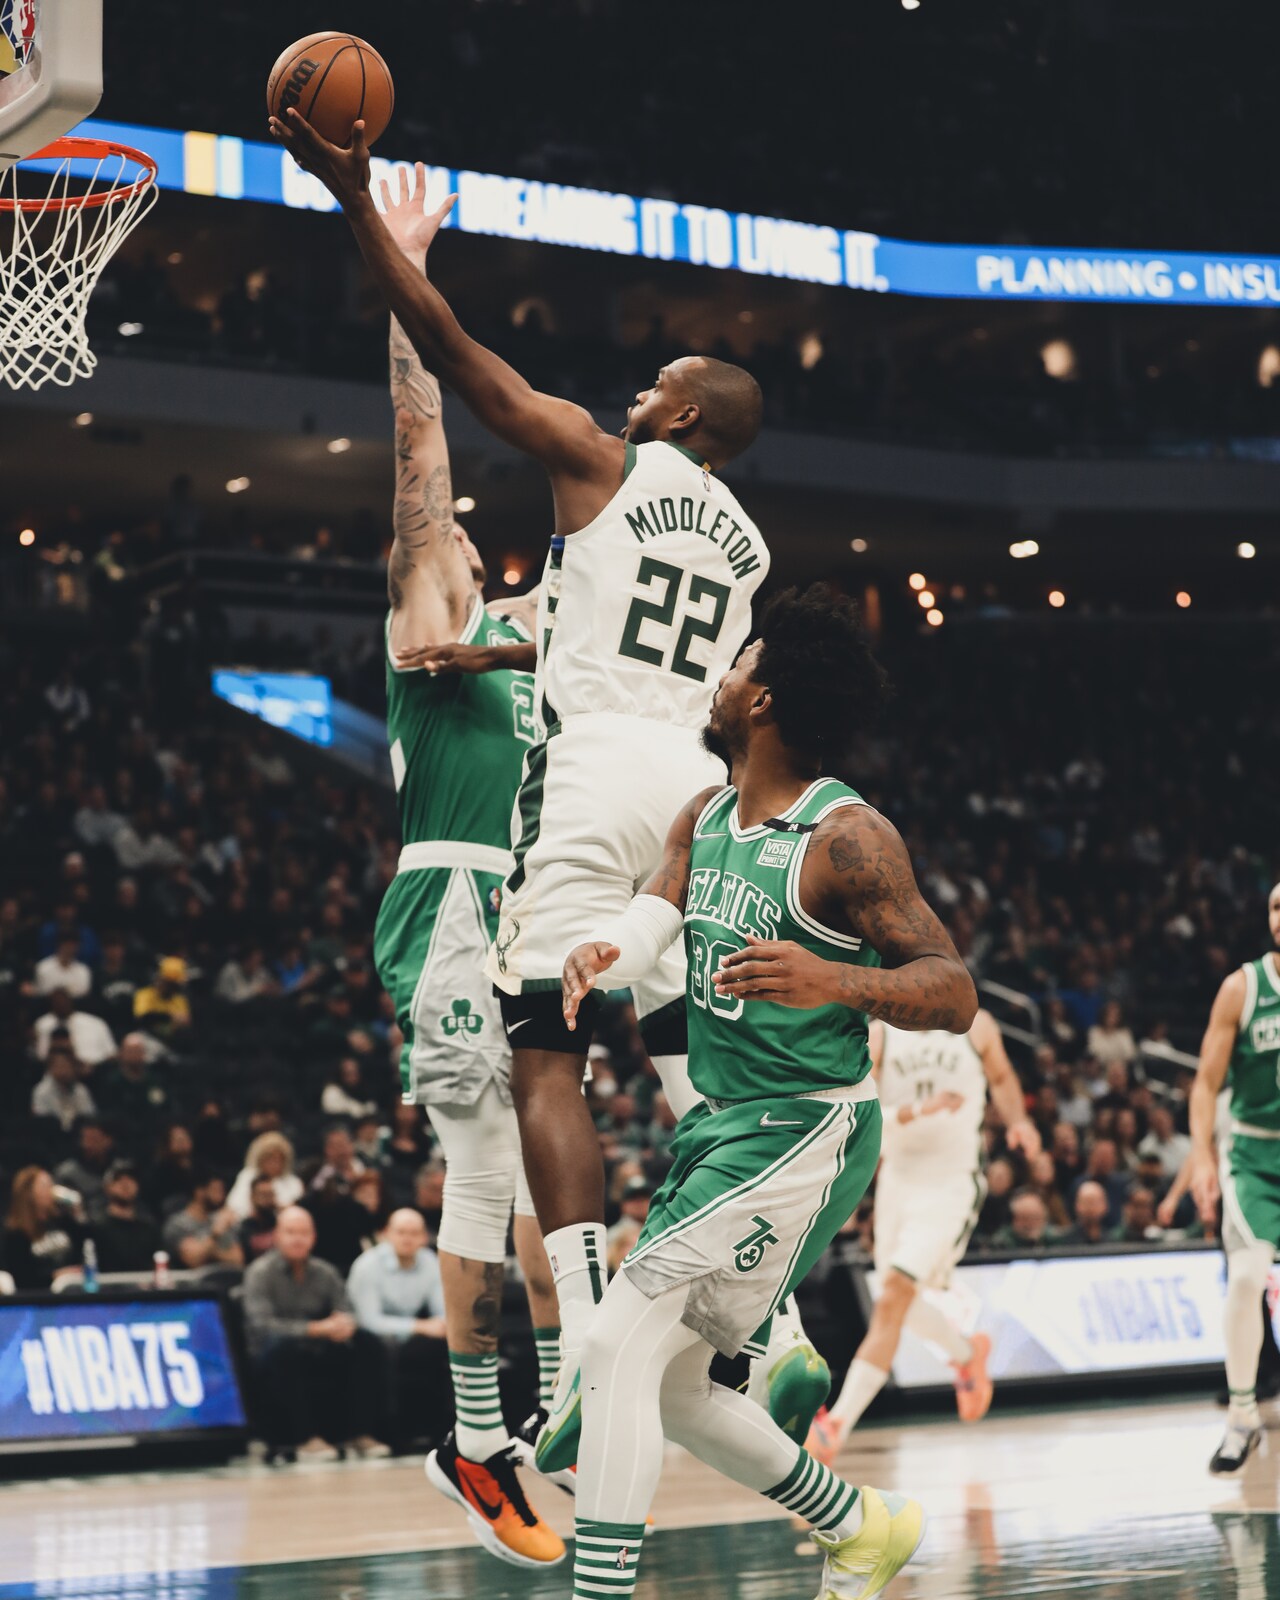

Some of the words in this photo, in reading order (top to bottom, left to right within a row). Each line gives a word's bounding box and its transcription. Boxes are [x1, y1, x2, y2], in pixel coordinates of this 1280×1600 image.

[681, 203, 733, 269] TO
[976, 255, 1173, 298] PLANNING
[624, 496, 761, 580] MIDDLETON
[617, 555, 732, 684] 22
[760, 855, 778, 866] PRINT
[766, 841, 791, 856] VISTA
[684, 868, 782, 941] ELTICS
[447, 1015, 477, 1030] RED
[731, 1213, 782, 1274] 75
[20, 1320, 205, 1415] #NBA75
